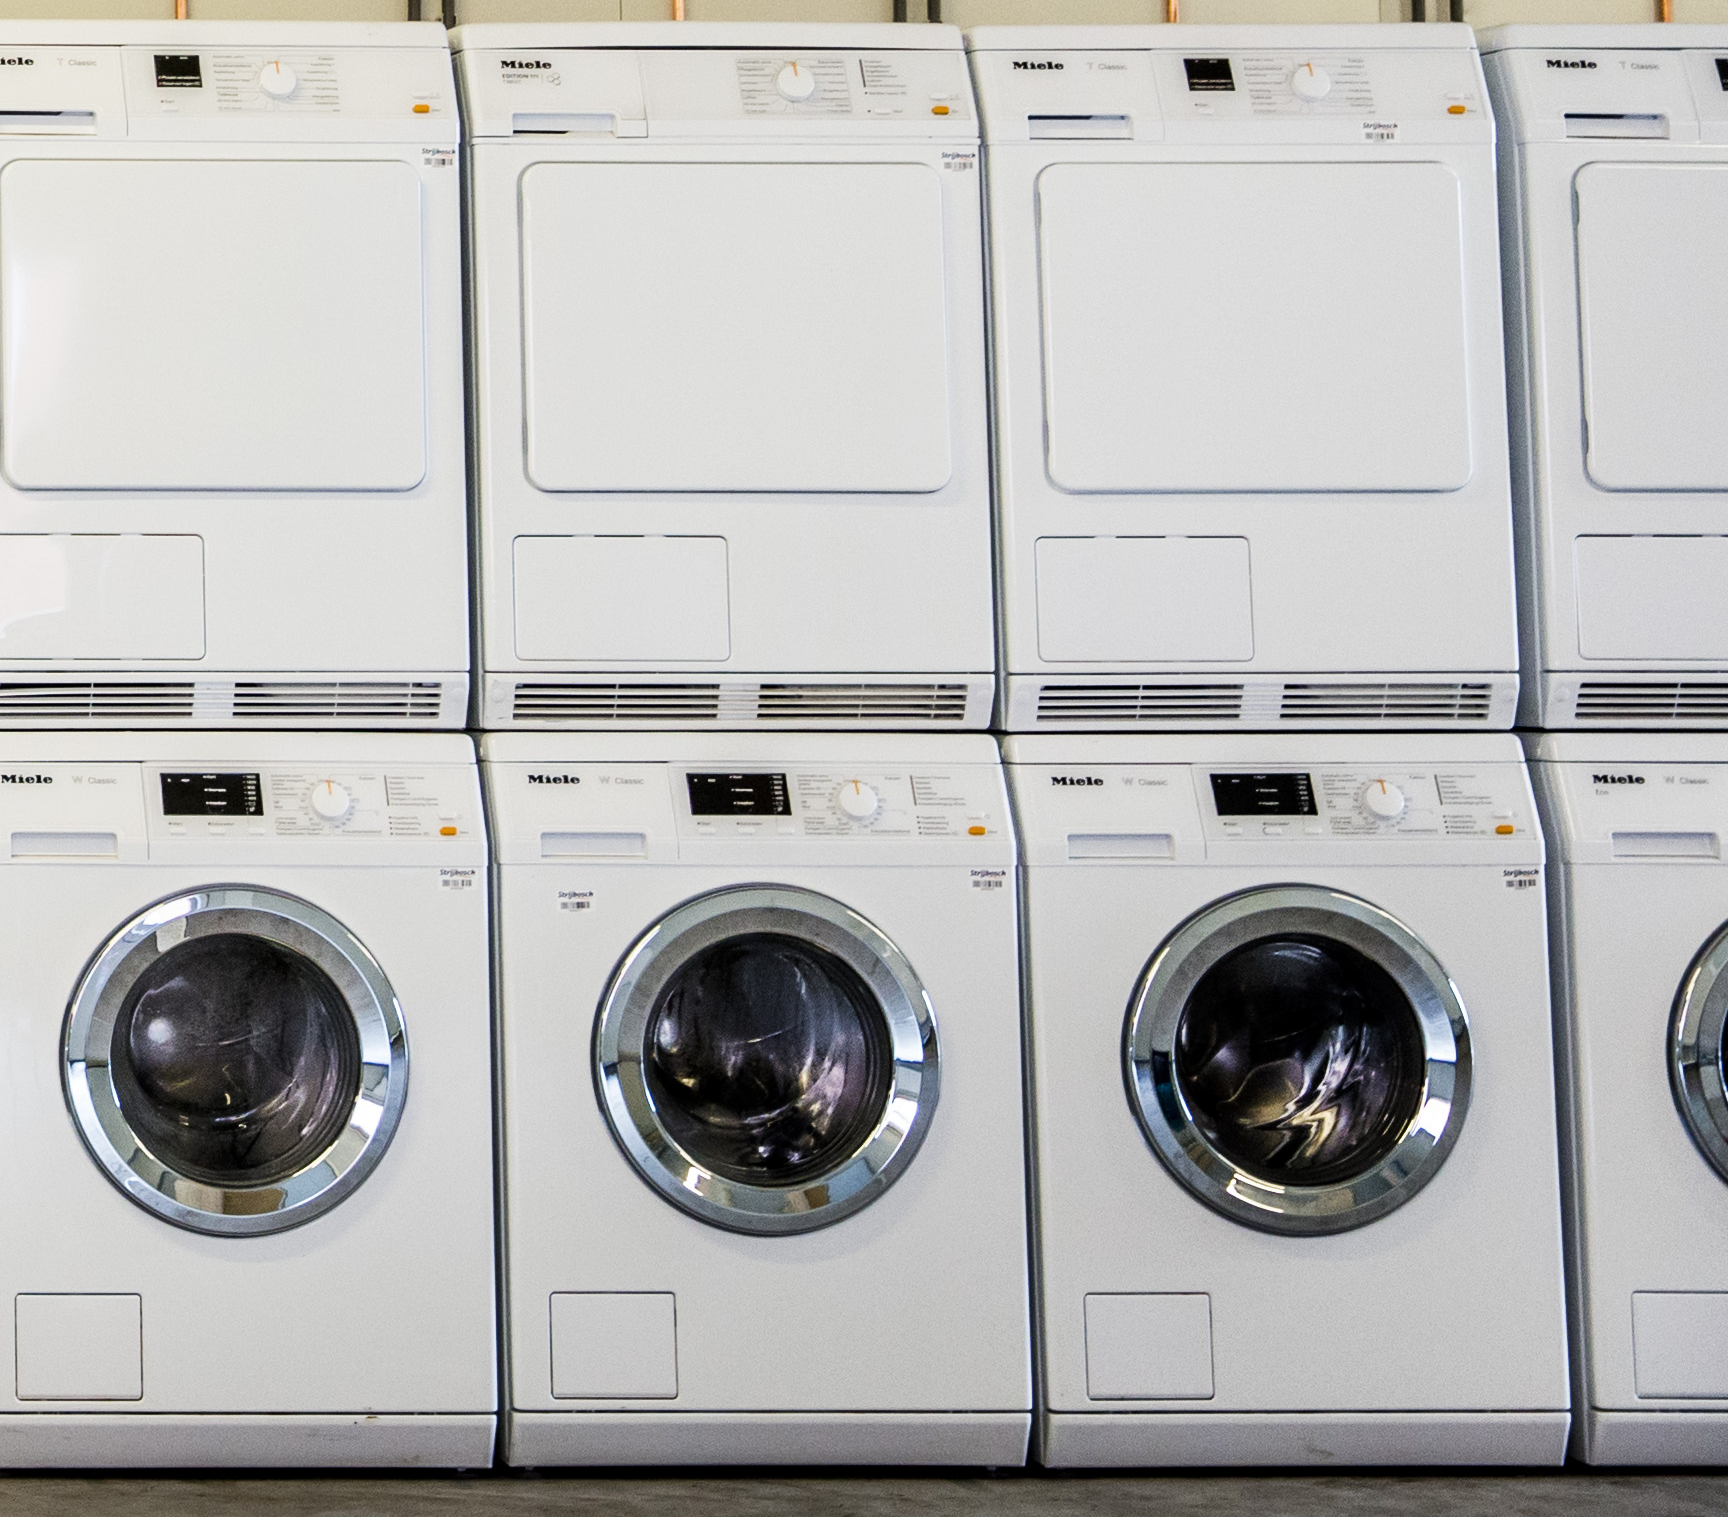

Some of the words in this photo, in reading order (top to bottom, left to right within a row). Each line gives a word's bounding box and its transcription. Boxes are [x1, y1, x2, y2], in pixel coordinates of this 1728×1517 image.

[67, 59, 97, 67] Classic
[500, 60, 552, 70] Miele
[1012, 60, 1065, 71] Miele
[1097, 63, 1127, 71] Classic
[1545, 59, 1598, 69] Miele
[0, 774, 53, 784] Miele
[86, 776, 117, 785] Classic
[527, 774, 581, 785] Miele
[613, 777, 644, 785] Classic
[1050, 776, 1104, 787] Miele
[1137, 778, 1168, 787] Classic
[1592, 774, 1646, 785] Miele
